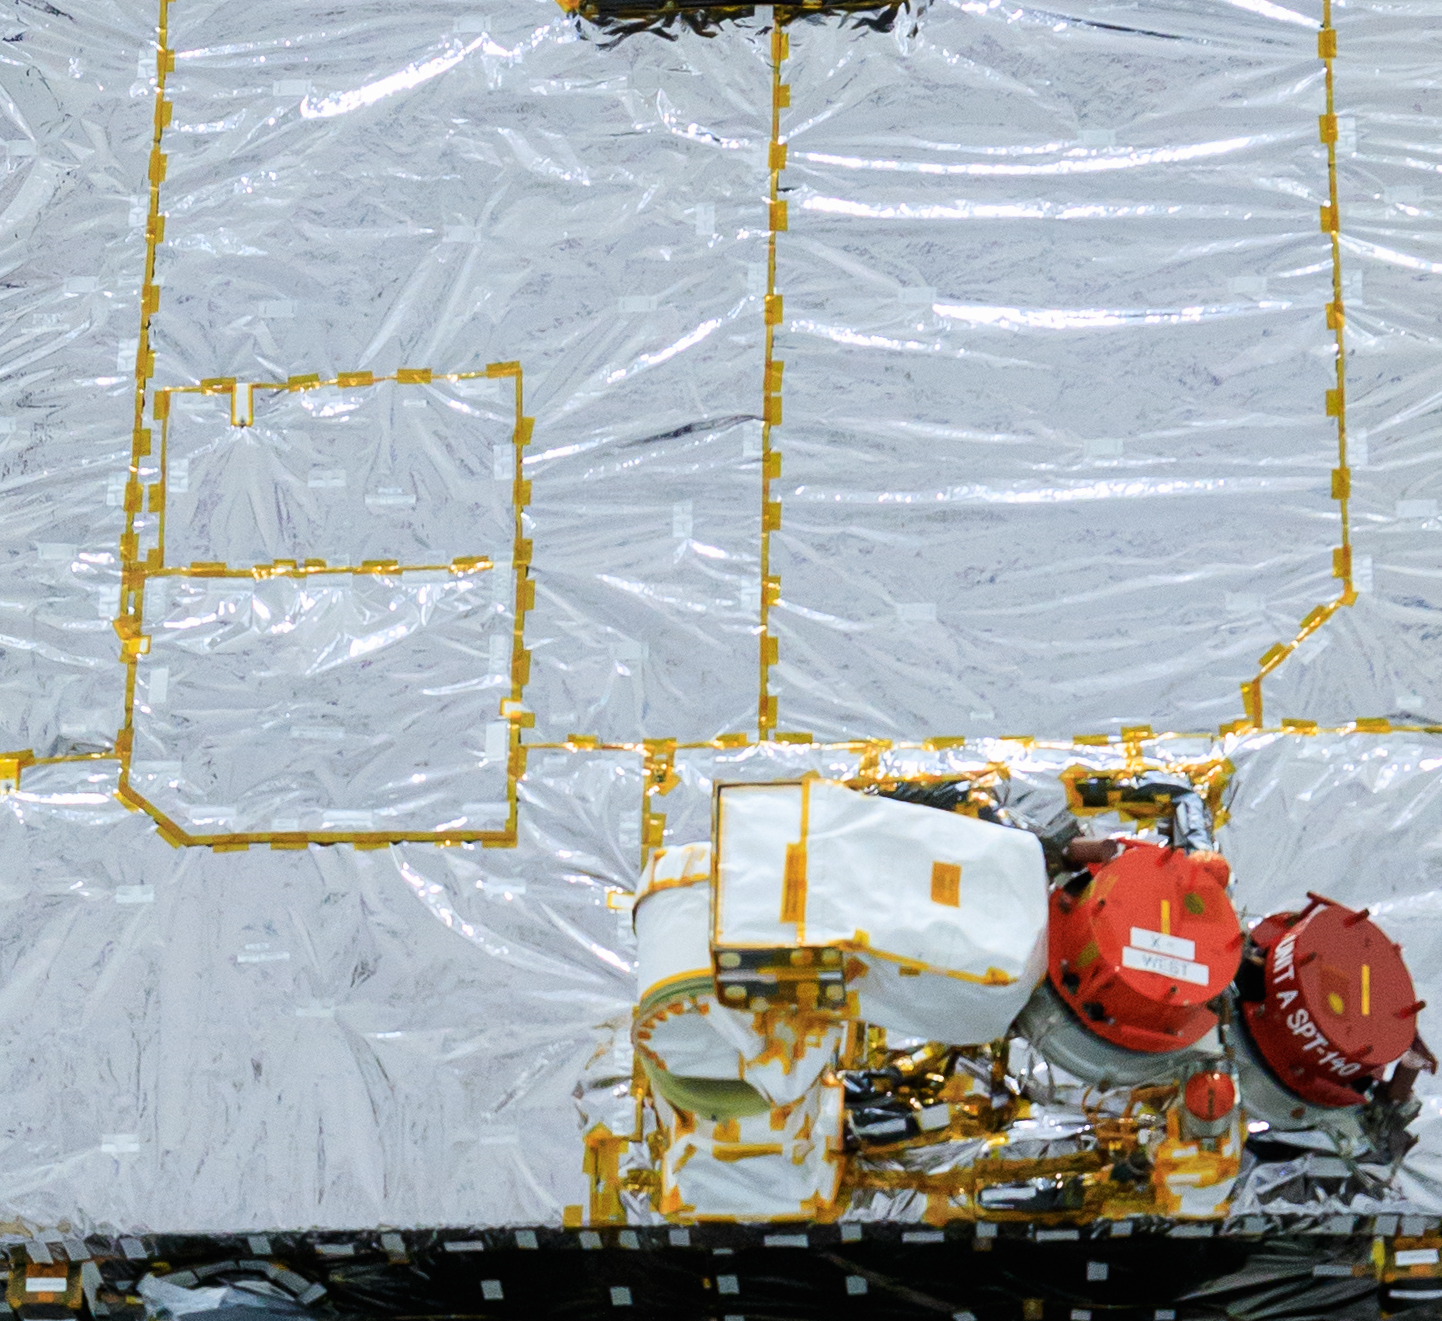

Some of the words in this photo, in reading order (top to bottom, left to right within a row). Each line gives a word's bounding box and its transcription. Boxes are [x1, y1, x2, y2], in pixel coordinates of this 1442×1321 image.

[1273, 934, 1297, 984] UNIT
[1276, 990, 1299, 1009] A
[1286, 1008, 1361, 1077] SPT-140
